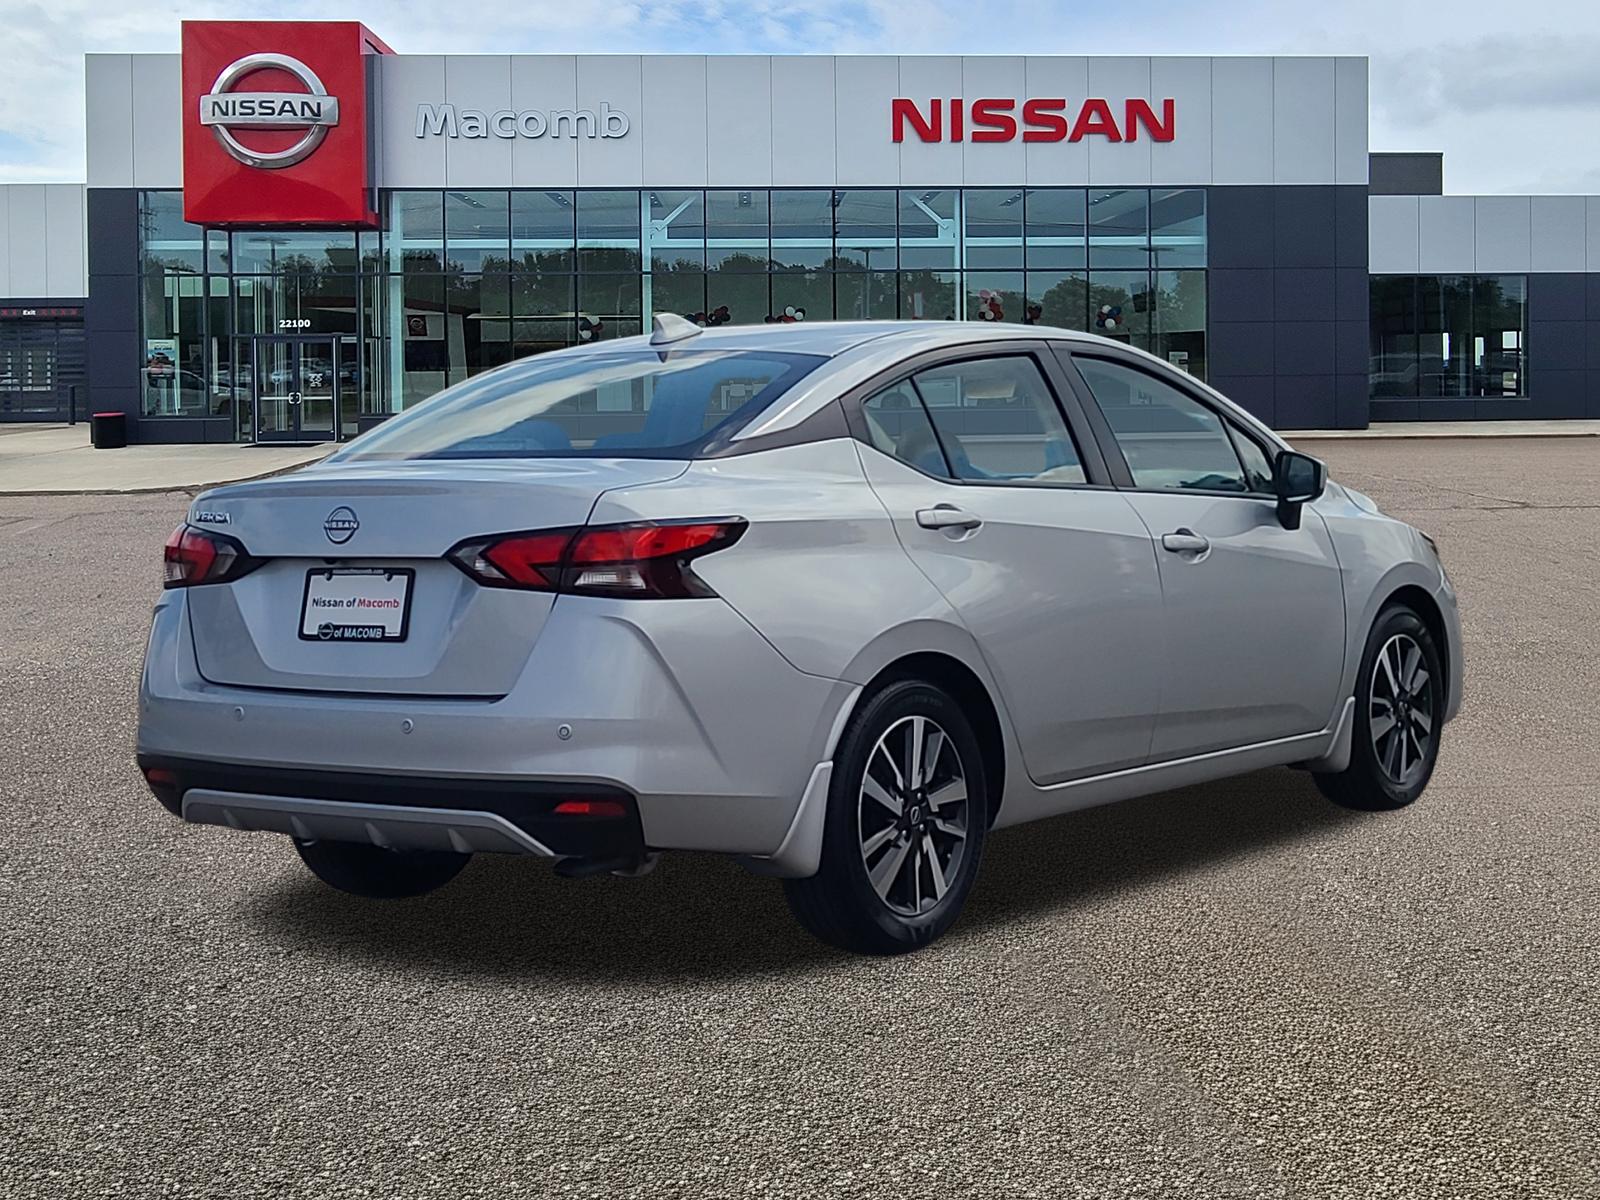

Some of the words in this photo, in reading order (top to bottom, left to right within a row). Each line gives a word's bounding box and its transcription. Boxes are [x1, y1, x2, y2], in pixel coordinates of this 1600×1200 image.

[212, 99, 322, 118] NISSAN
[415, 101, 630, 139] Macomb
[892, 98, 1175, 143] NISSAN
[279, 319, 311, 328] 22100
[195, 510, 232, 525] VERSA
[324, 521, 358, 529] NISSAN
[311, 597, 344, 608] Nissan
[346, 597, 357, 608] of
[357, 598, 400, 609] Macomb
[333, 626, 344, 638] of
[344, 627, 383, 639] MACOMB
